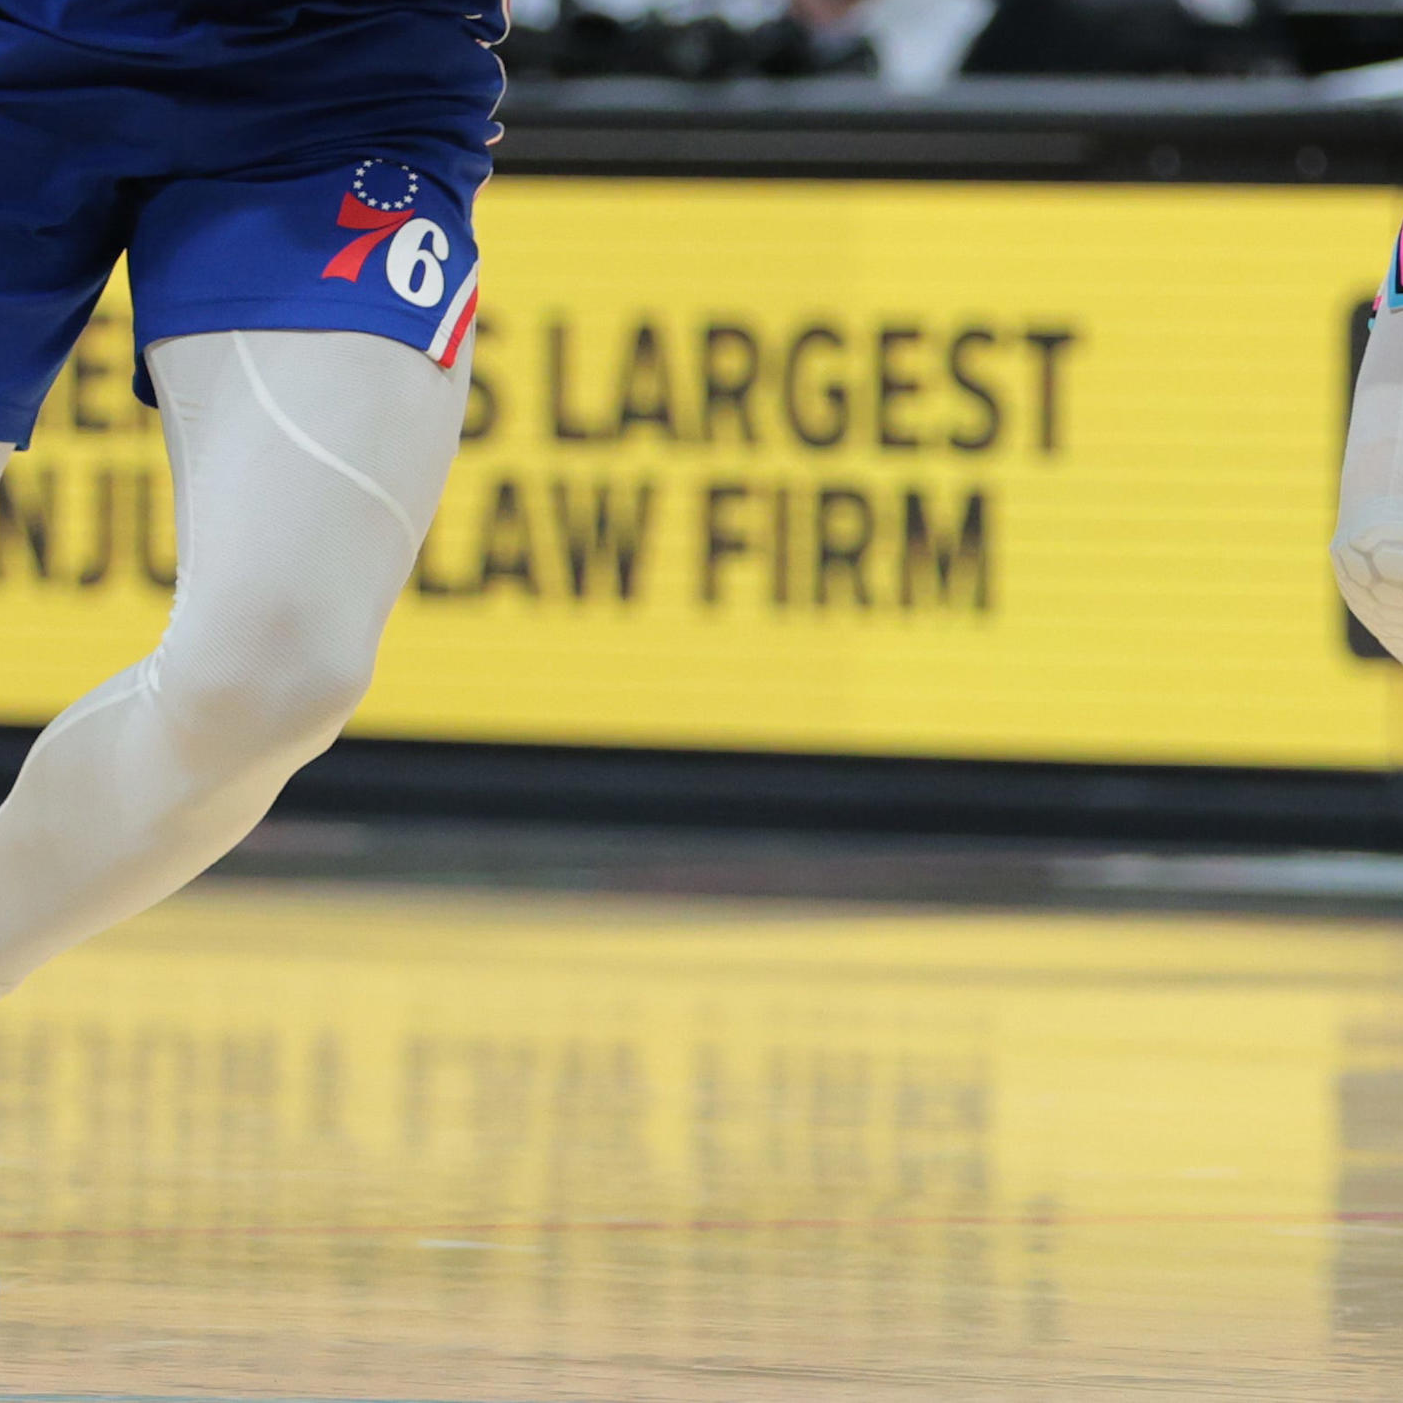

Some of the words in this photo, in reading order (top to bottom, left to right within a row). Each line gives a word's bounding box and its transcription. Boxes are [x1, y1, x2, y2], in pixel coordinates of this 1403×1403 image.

[321, 191, 450, 308] 76
[548, 311, 1078, 456] LARGEST
[702, 484, 994, 612] FIRM
